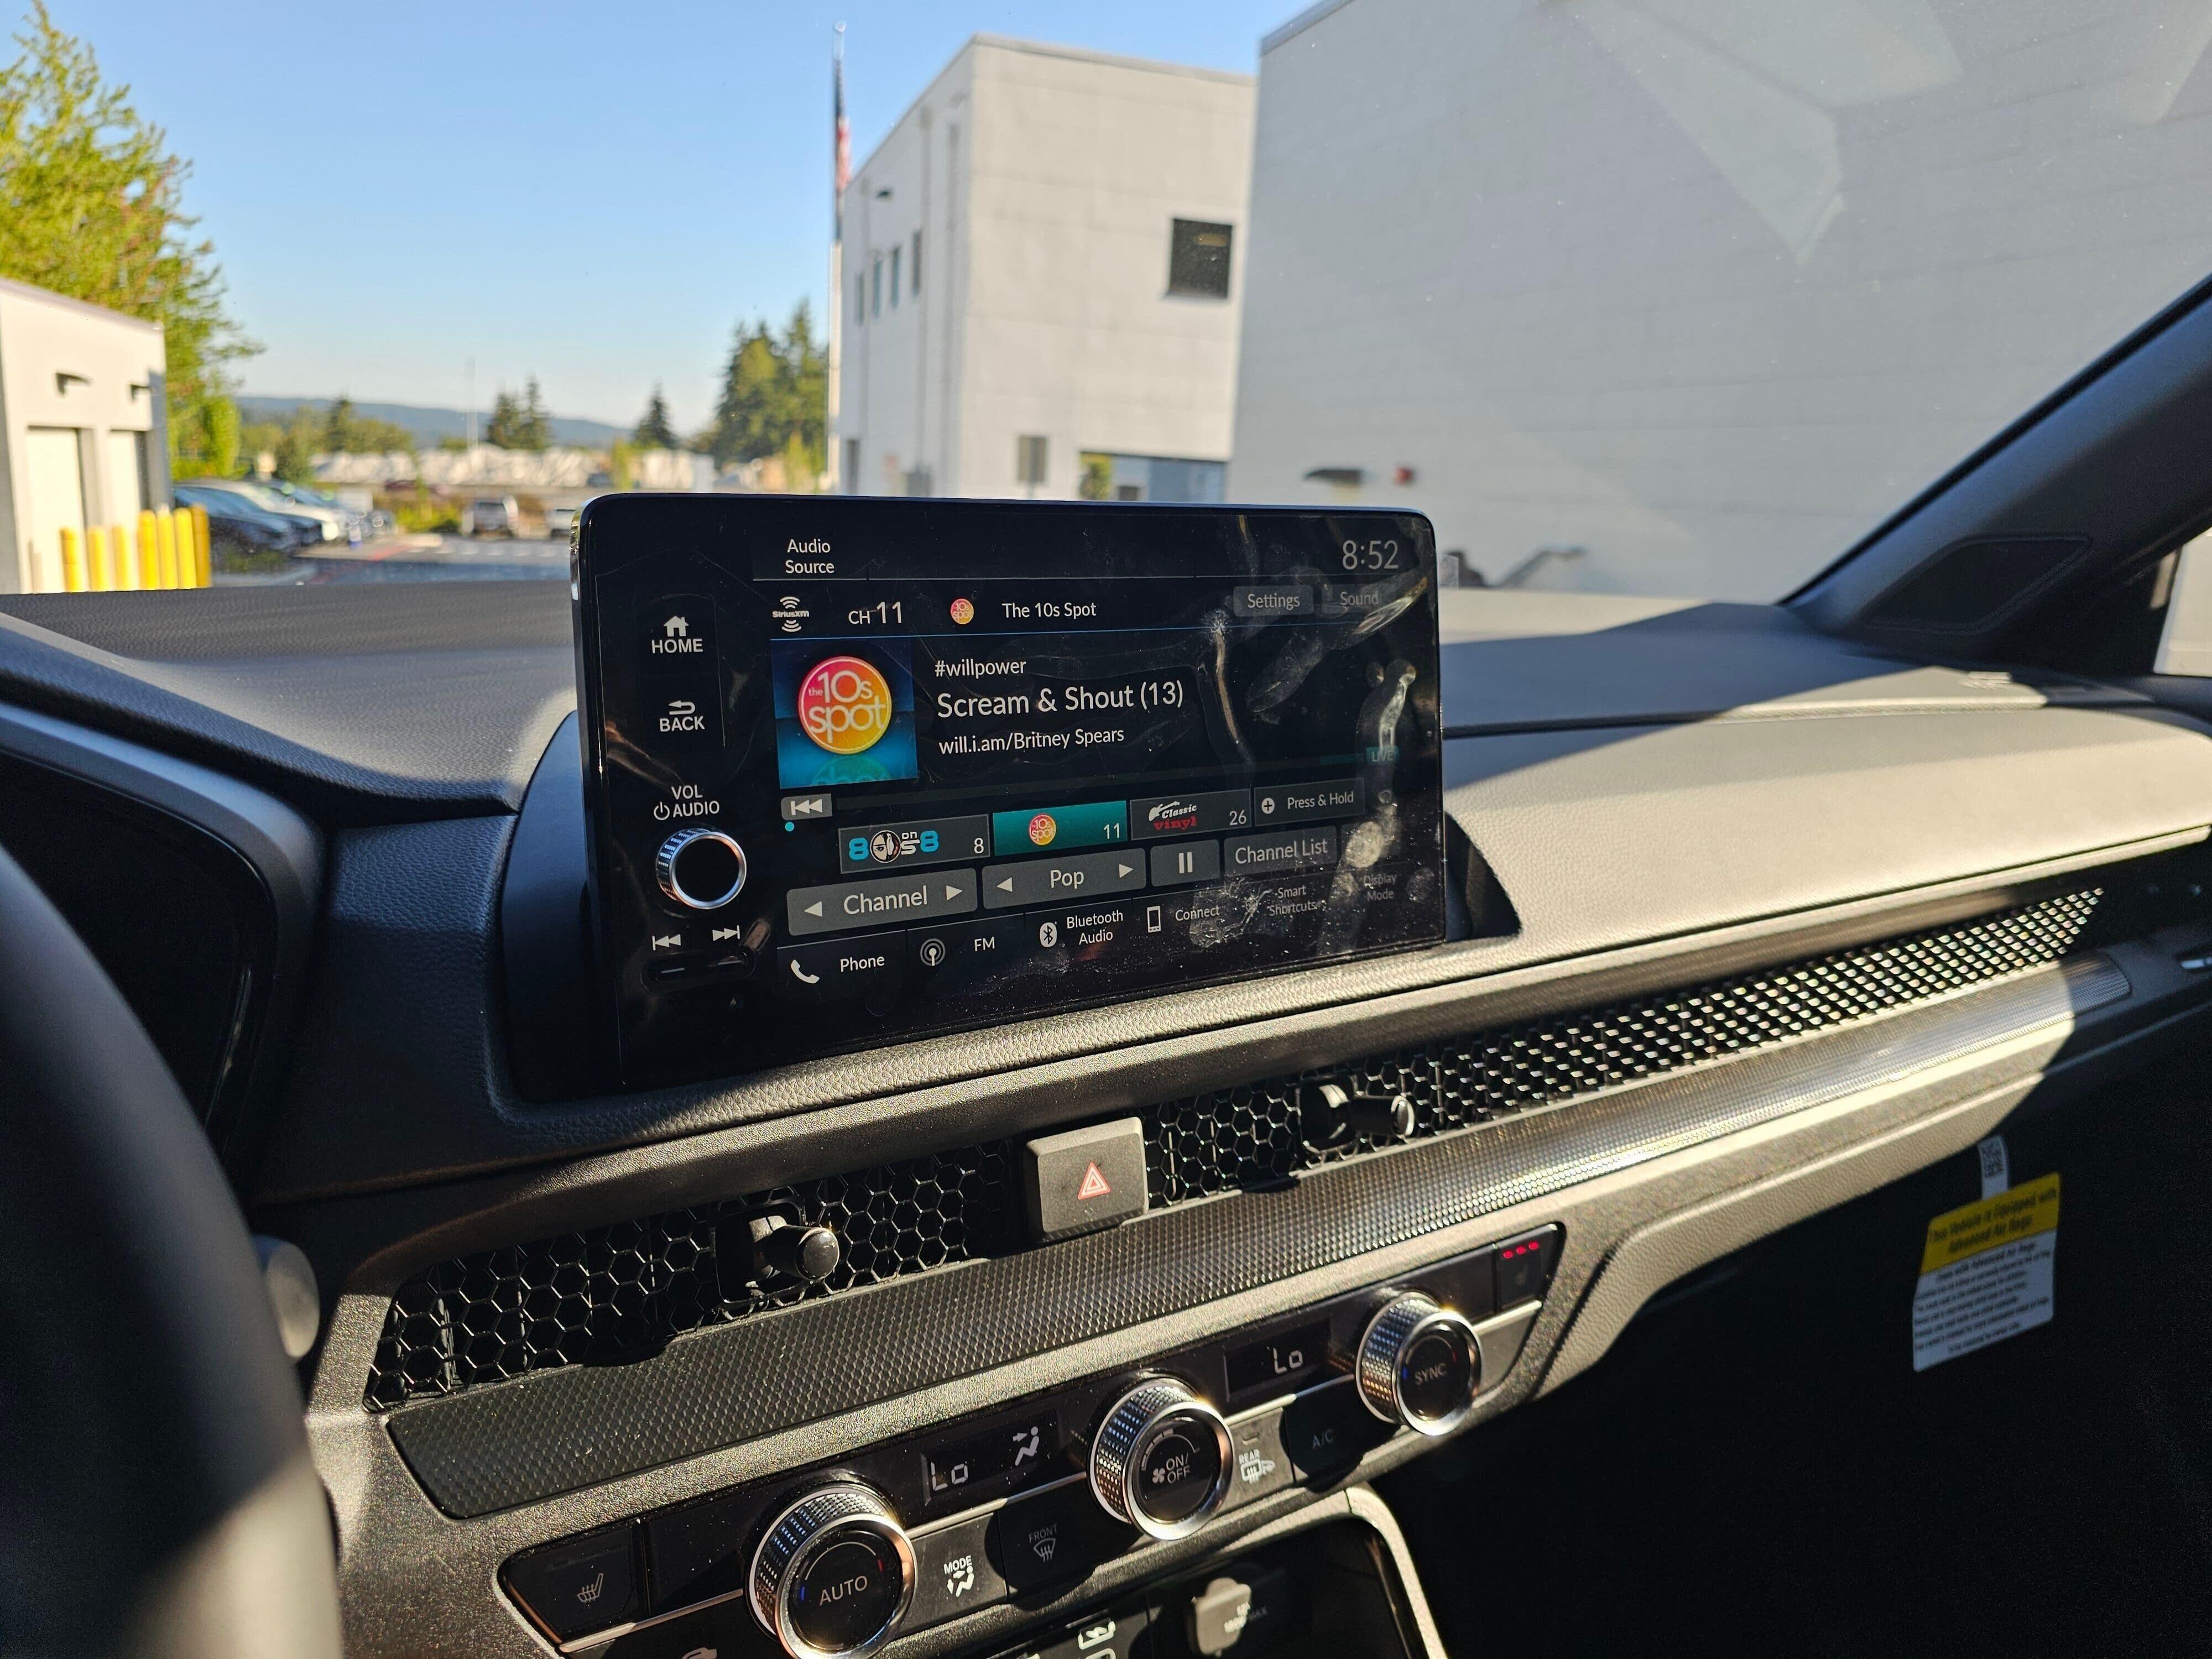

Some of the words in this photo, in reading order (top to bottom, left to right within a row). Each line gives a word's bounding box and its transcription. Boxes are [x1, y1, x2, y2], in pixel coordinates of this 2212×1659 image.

[787, 538, 831, 554] Audio
[1342, 540, 1399, 570] 8:52
[785, 560, 834, 574] Source
[1248, 592, 1300, 612] Settings
[1340, 591, 1379, 607] Sound
[848, 612, 871, 624] CH
[877, 602, 902, 624] 11
[1001, 603, 1030, 618] The
[1034, 602, 1060, 618] 10s
[1063, 602, 1097, 620] Spot
[651, 639, 703, 654] HOME
[935, 658, 1026, 679] #willpower
[808, 687, 823, 696] the
[818, 670, 873, 703] 10s
[937, 692, 1029, 718] Scream
[1037, 690, 1057, 712] &
[1065, 685, 1133, 710] Shout
[1140, 680, 1183, 709] (13)
[659, 716, 705, 733] BACK
[808, 695, 885, 743] spot
[939, 729, 1070, 756] will.i.am/Britney
[1074, 727, 1125, 748] Spears
[1371, 749, 1394, 762] LIVE
[671, 785, 703, 800] VOL
[1287, 797, 1315, 810] Press
[1318, 794, 1327, 806] &
[1330, 791, 1354, 805] Hold
[673, 801, 720, 818] AUDIO
[1162, 804, 1197, 820] Classic
[1229, 810, 1247, 826] 26
[1103, 823, 1120, 839] 11
[973, 837, 984, 854] 8
[1235, 841, 1298, 864] Channel
[1302, 838, 1328, 856] List
[1050, 869, 1084, 888] Pop
[1364, 874, 1397, 887] Display
[843, 886, 927, 915] Channel
[1277, 885, 1306, 899] Smart
[1367, 889, 1394, 902] Mode
[1175, 905, 1220, 921] Connect
[1269, 900, 1318, 916] Shortcuts
[1067, 909, 1124, 929] Bluetooth
[974, 938, 995, 952] FM
[1079, 930, 1113, 946] Audio
[840, 954, 885, 973] Phone
[1274, 1348, 1303, 1374] Lo
[1415, 1363, 1447, 1383] SYNC
[1312, 1430, 1333, 1450] A/C
[1165, 1452, 1189, 1472] ON/
[1239, 1449, 1260, 1464] REAR
[931, 1460, 969, 1491] Lo
[1167, 1465, 1191, 1484] OFF
[1029, 1524, 1057, 1542] FRONT
[943, 1554, 972, 1574] MODE
[819, 1575, 869, 1606] AUTO
